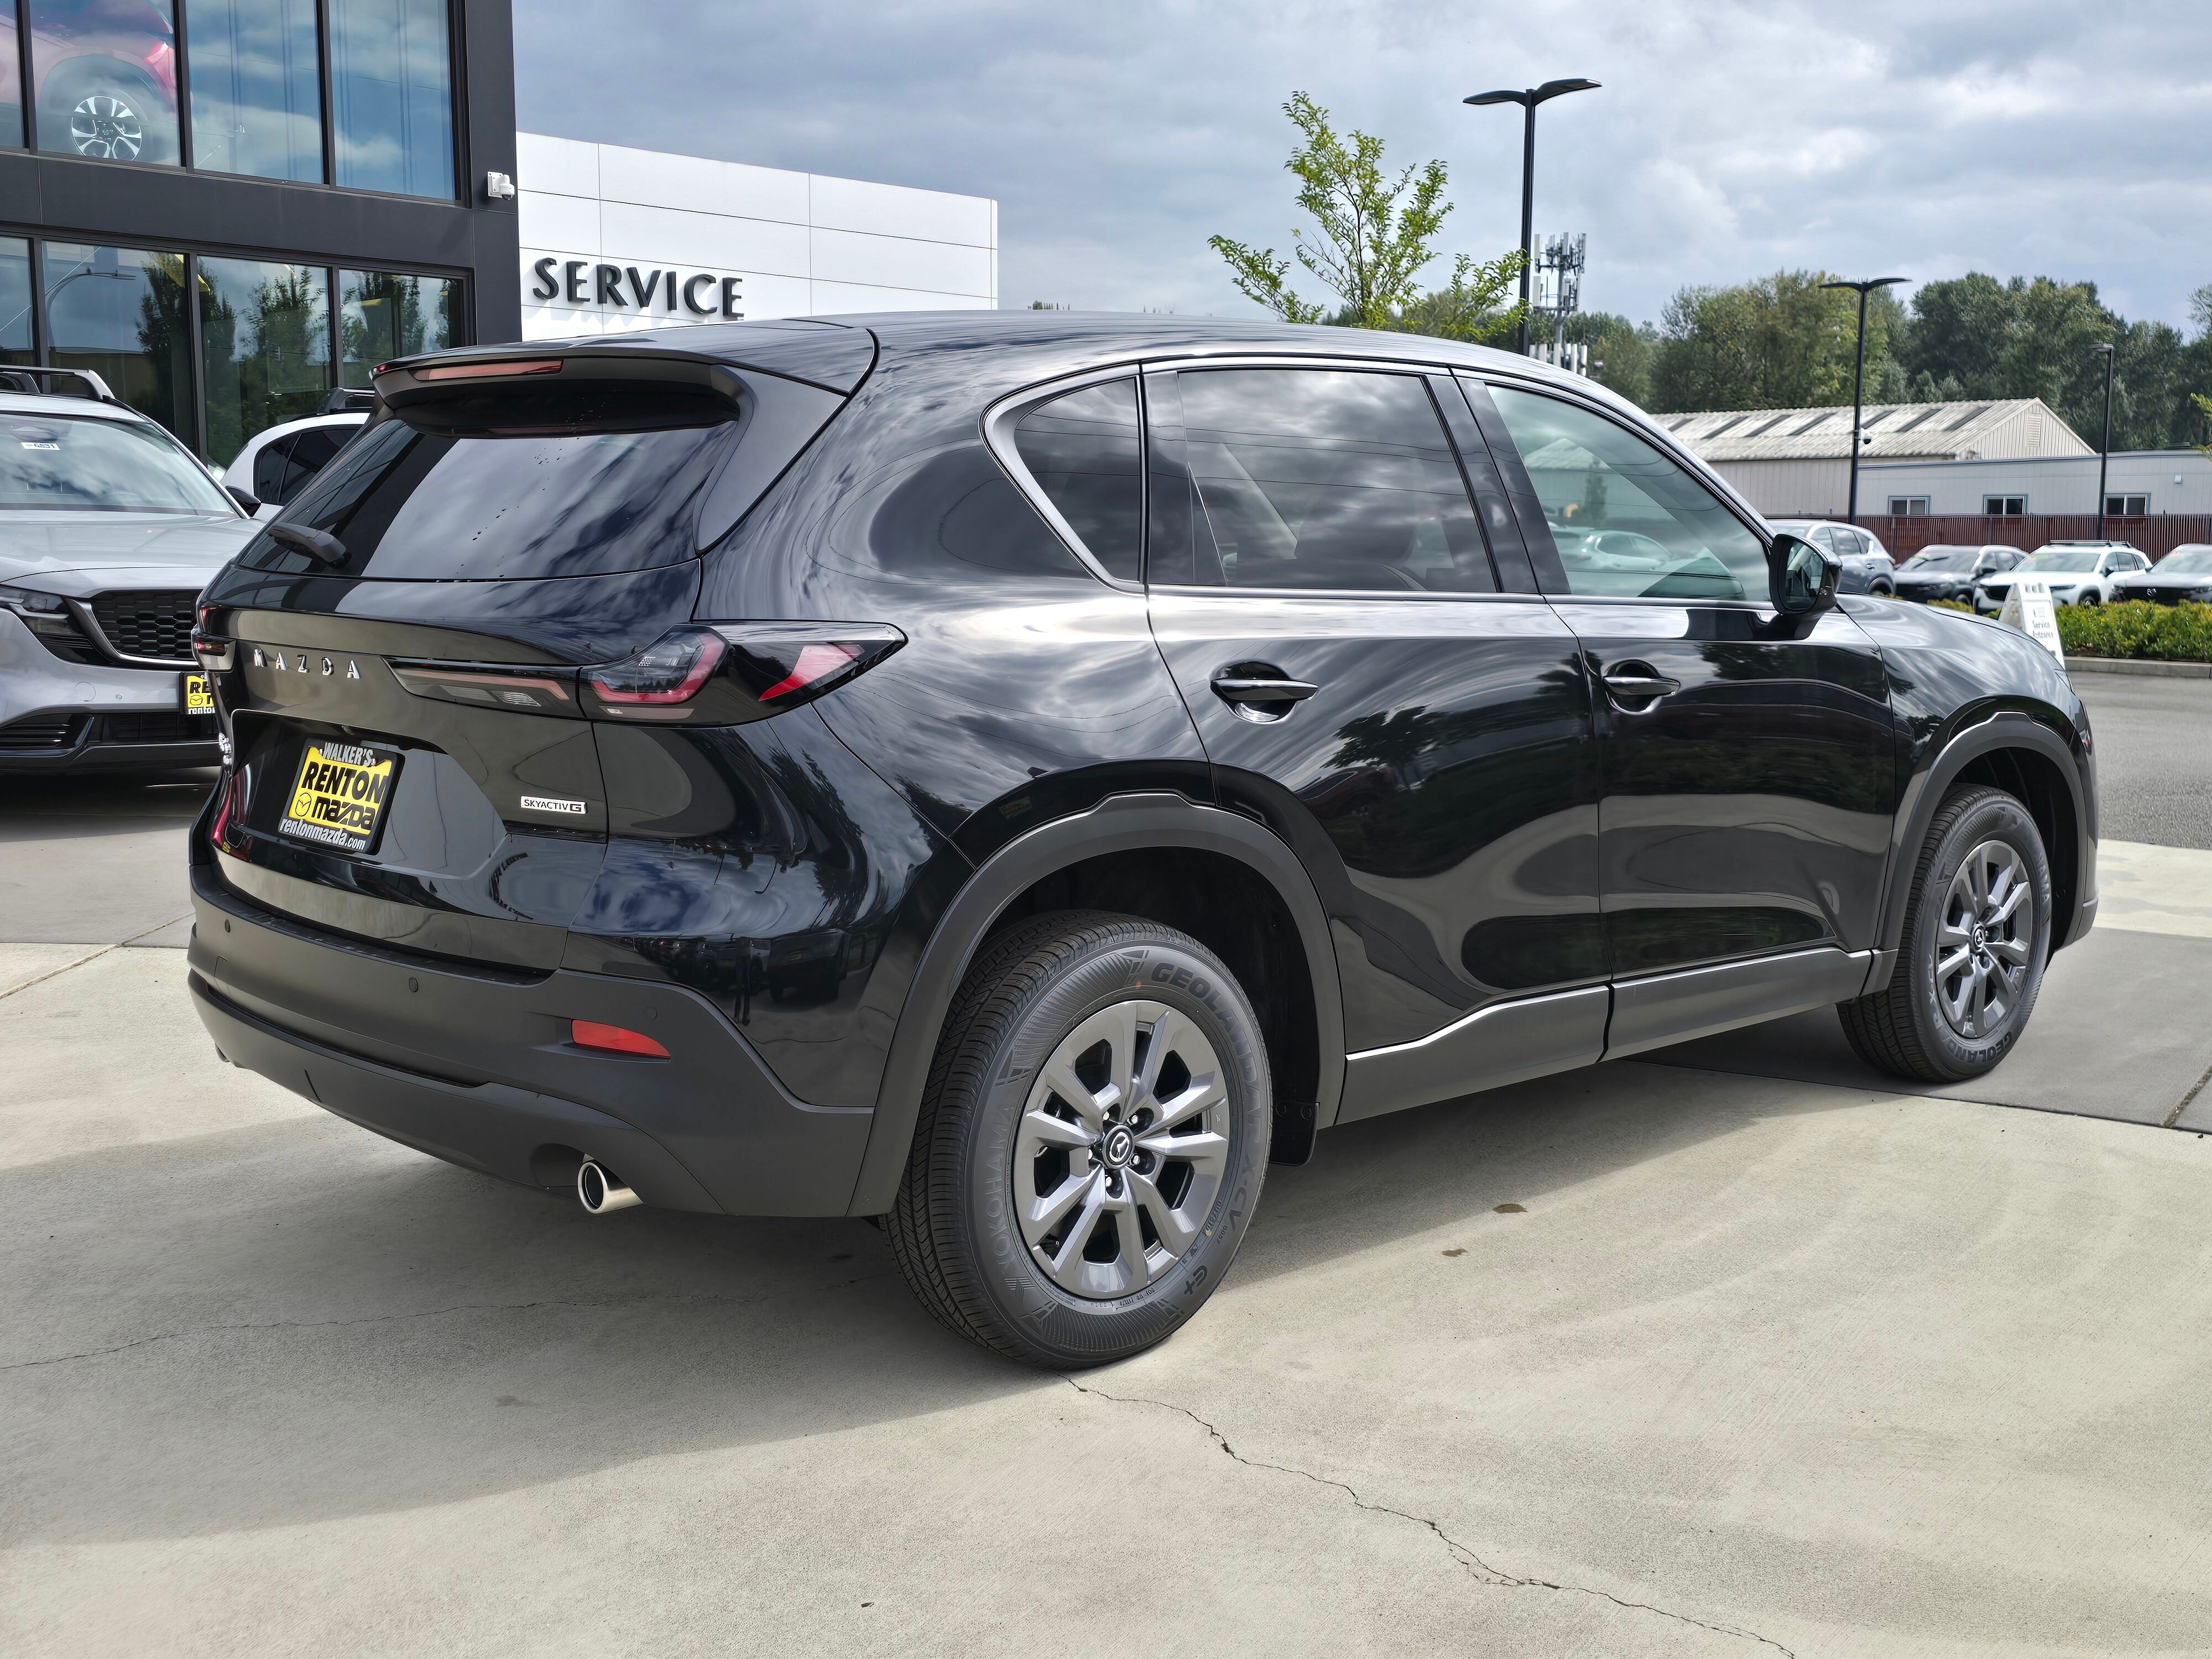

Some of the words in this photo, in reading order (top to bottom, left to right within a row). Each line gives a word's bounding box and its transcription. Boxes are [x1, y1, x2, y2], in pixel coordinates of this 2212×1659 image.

[533, 257, 744, 317] SERVICE
[254, 649, 360, 680] MAZDA
[322, 742, 374, 767] WALKER'S
[301, 761, 389, 804] RENTON
[311, 796, 376, 831] mazda
[279, 818, 366, 851] rentonmazda.com
